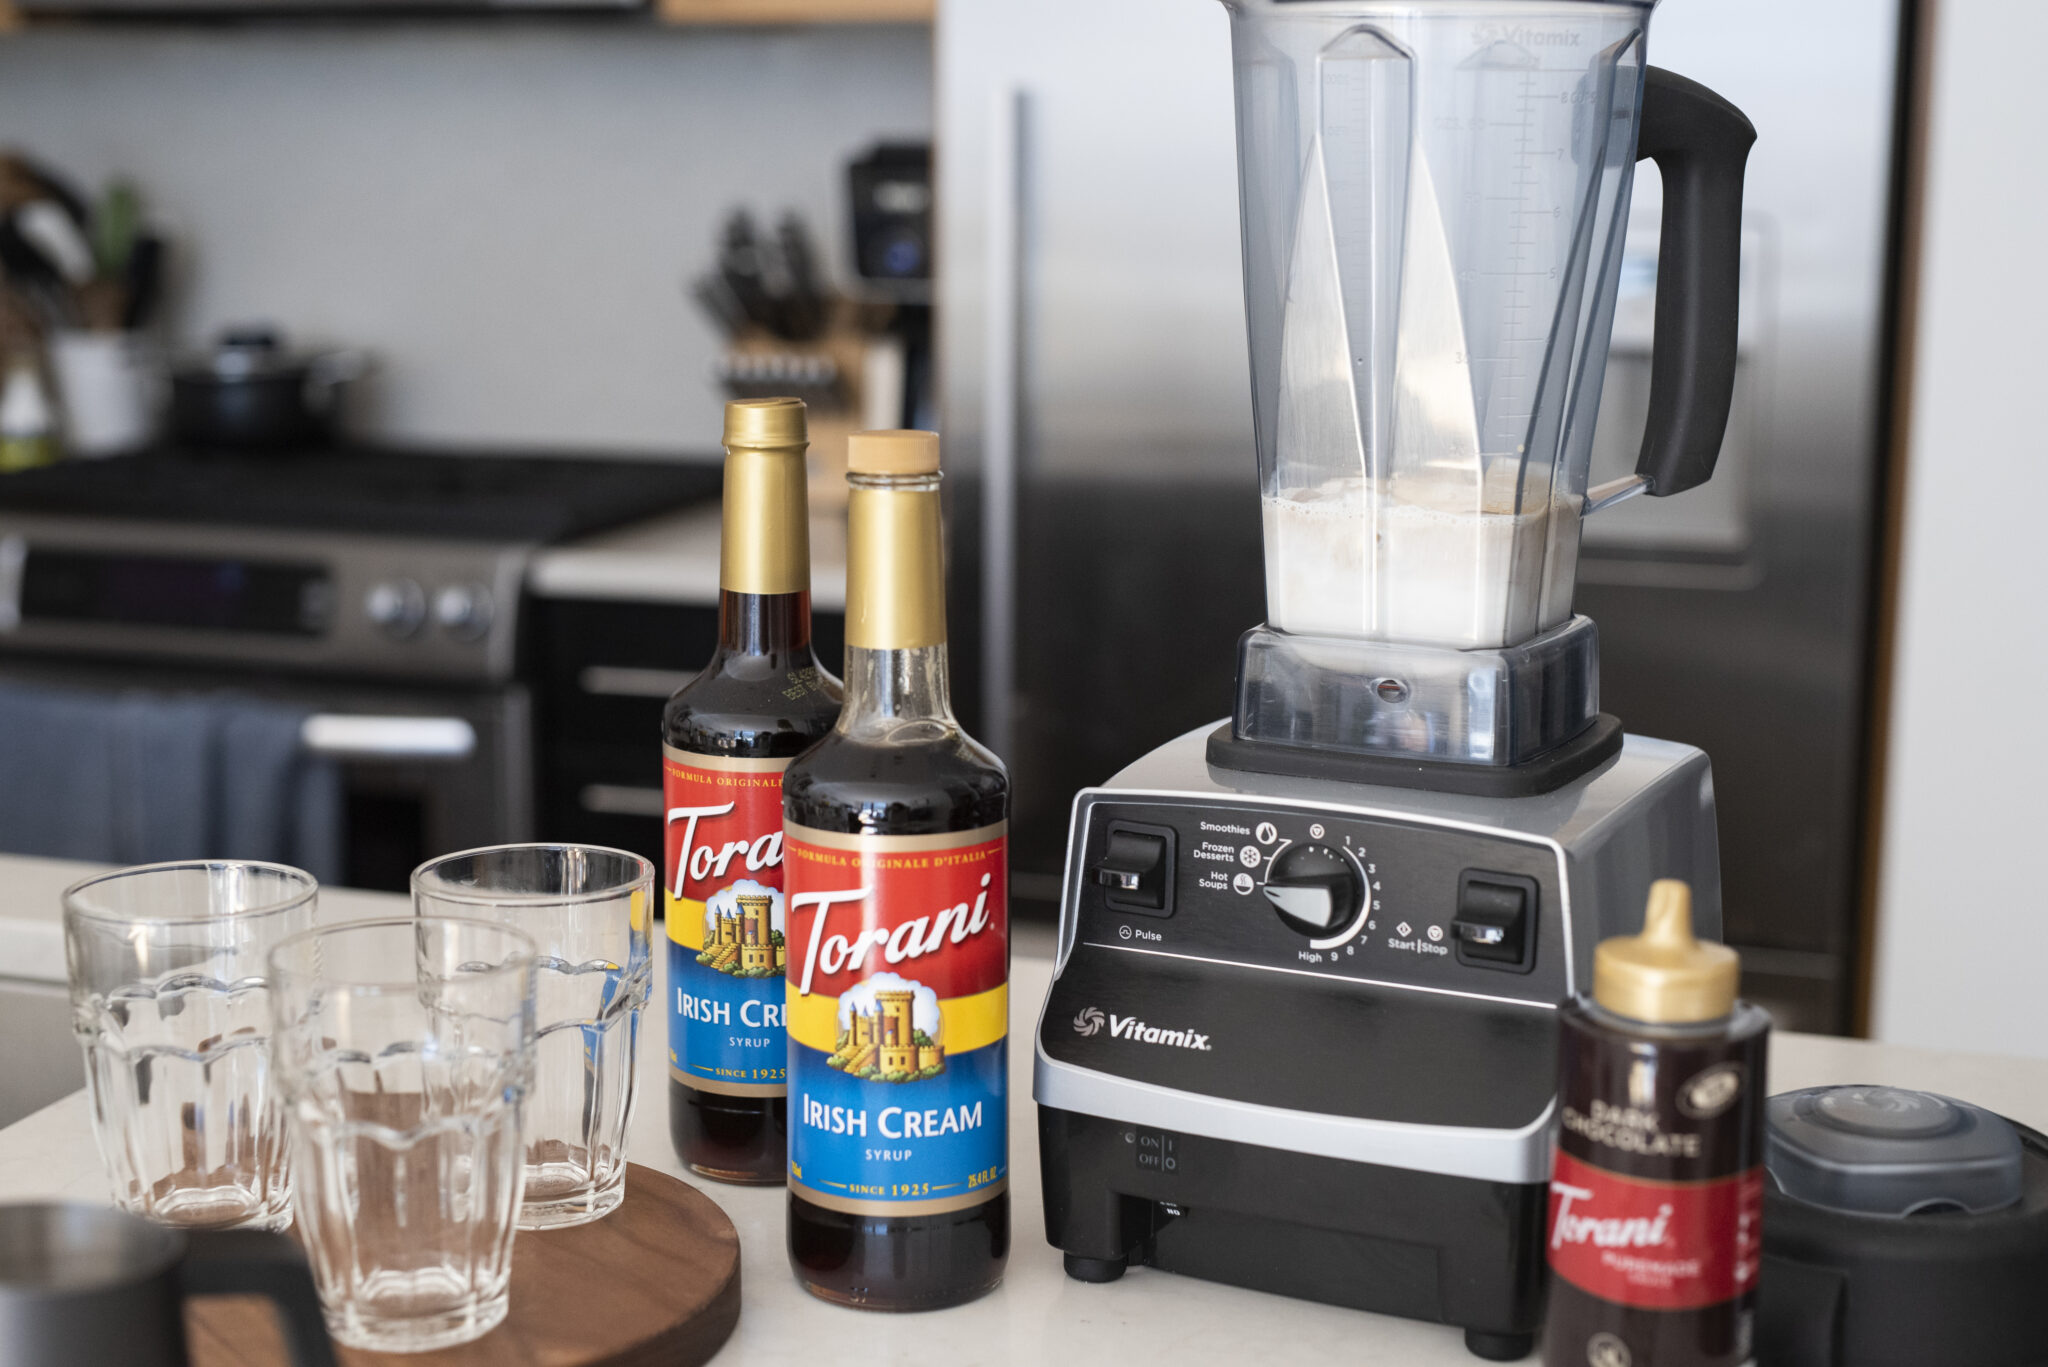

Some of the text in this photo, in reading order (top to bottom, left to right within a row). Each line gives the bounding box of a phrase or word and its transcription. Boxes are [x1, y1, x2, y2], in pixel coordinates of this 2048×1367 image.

[1503, 25, 1581, 47] Vitamix
[672, 768, 712, 784] FORMULA
[1200, 821, 1250, 835] Smoothies
[1345, 836, 1350, 845] 1
[668, 801, 785, 900] Tora
[1202, 842, 1234, 853] Frozen
[1358, 847, 1366, 857] 2
[798, 848, 847, 867] FORMULA
[851, 857, 929, 870] OGINALE
[1193, 849, 1234, 862] Desserts
[1368, 864, 1376, 873] 3
[1211, 871, 1228, 881] Hot
[1199, 878, 1228, 890] Soups
[1373, 881, 1381, 891] 4
[1373, 900, 1380, 910] 5
[1368, 920, 1376, 930] 6
[791, 873, 991, 995] Torani
[1135, 928, 1162, 942] Pulse
[1361, 935, 1368, 945] 7
[1331, 952, 1338, 961] 9
[1347, 946, 1354, 955] 8
[1298, 951, 1322, 963] High
[677, 987, 731, 1026] IRISH
[1109, 1014, 1210, 1050] Vitamix
[729, 1036, 770, 1048] SYRUP
[715, 1067, 786, 1079] SINCE 1925
[803, 1093, 982, 1139] IRISH CREAM
[1561, 1106, 1699, 1158] CHOCOLATE
[1141, 1136, 1159, 1148] ON
[865, 1149, 912, 1161] SYRUP
[1139, 1154, 1159, 1166] OFF
[849, 1183, 929, 1196] SINCE 1925
[1551, 1181, 1674, 1249] Torani
